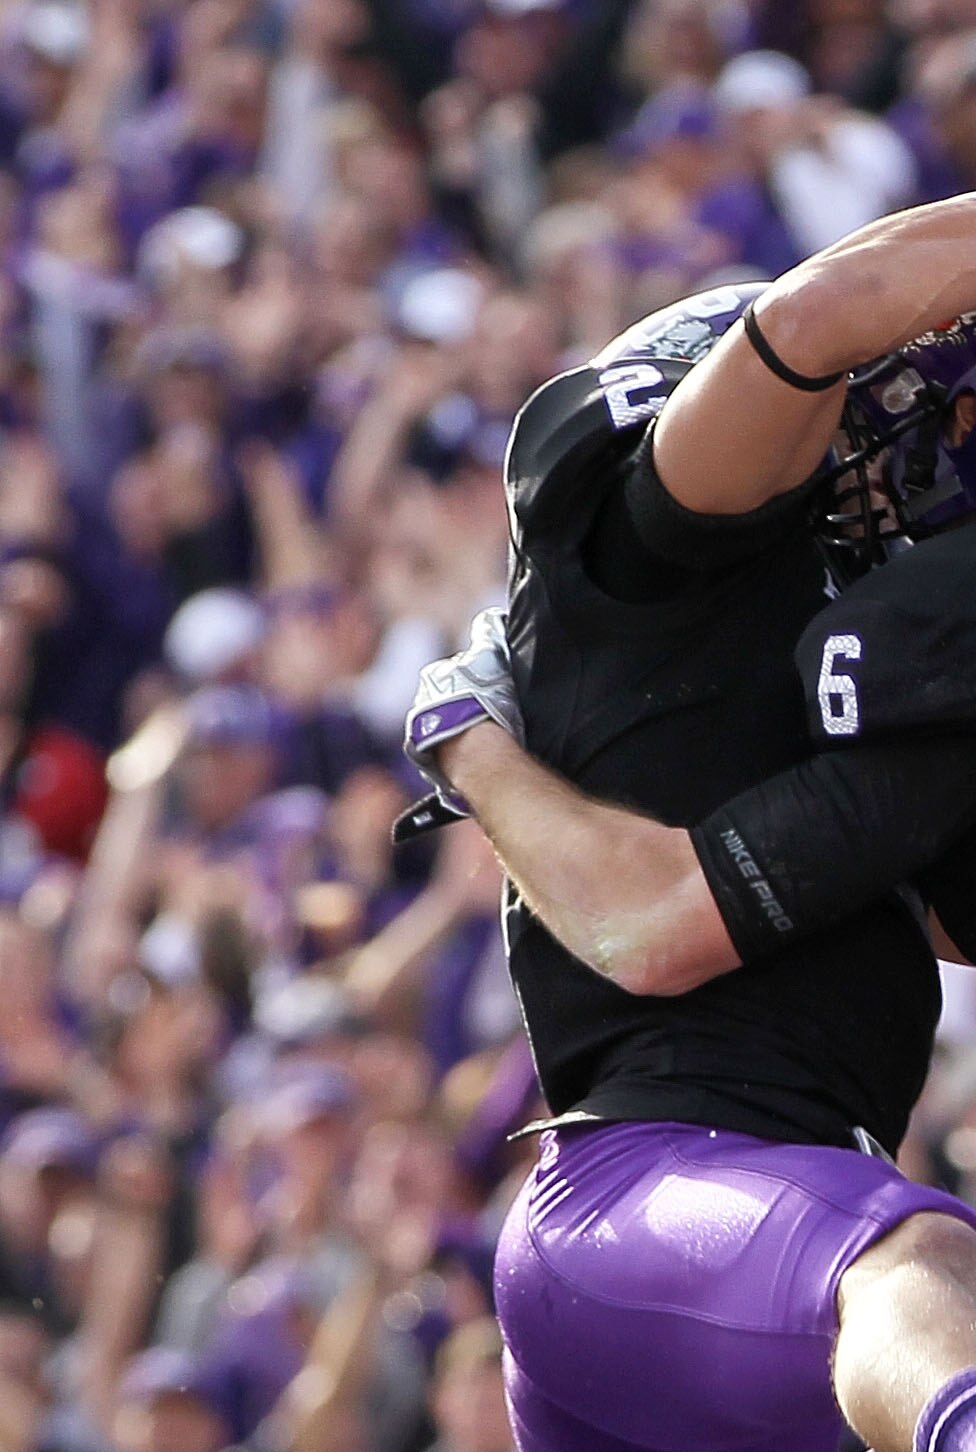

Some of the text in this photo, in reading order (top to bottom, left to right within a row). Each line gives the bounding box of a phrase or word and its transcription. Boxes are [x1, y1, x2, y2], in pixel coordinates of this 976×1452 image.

[818, 634, 861, 734] 6
[720, 827, 794, 932] NIKE PRO
